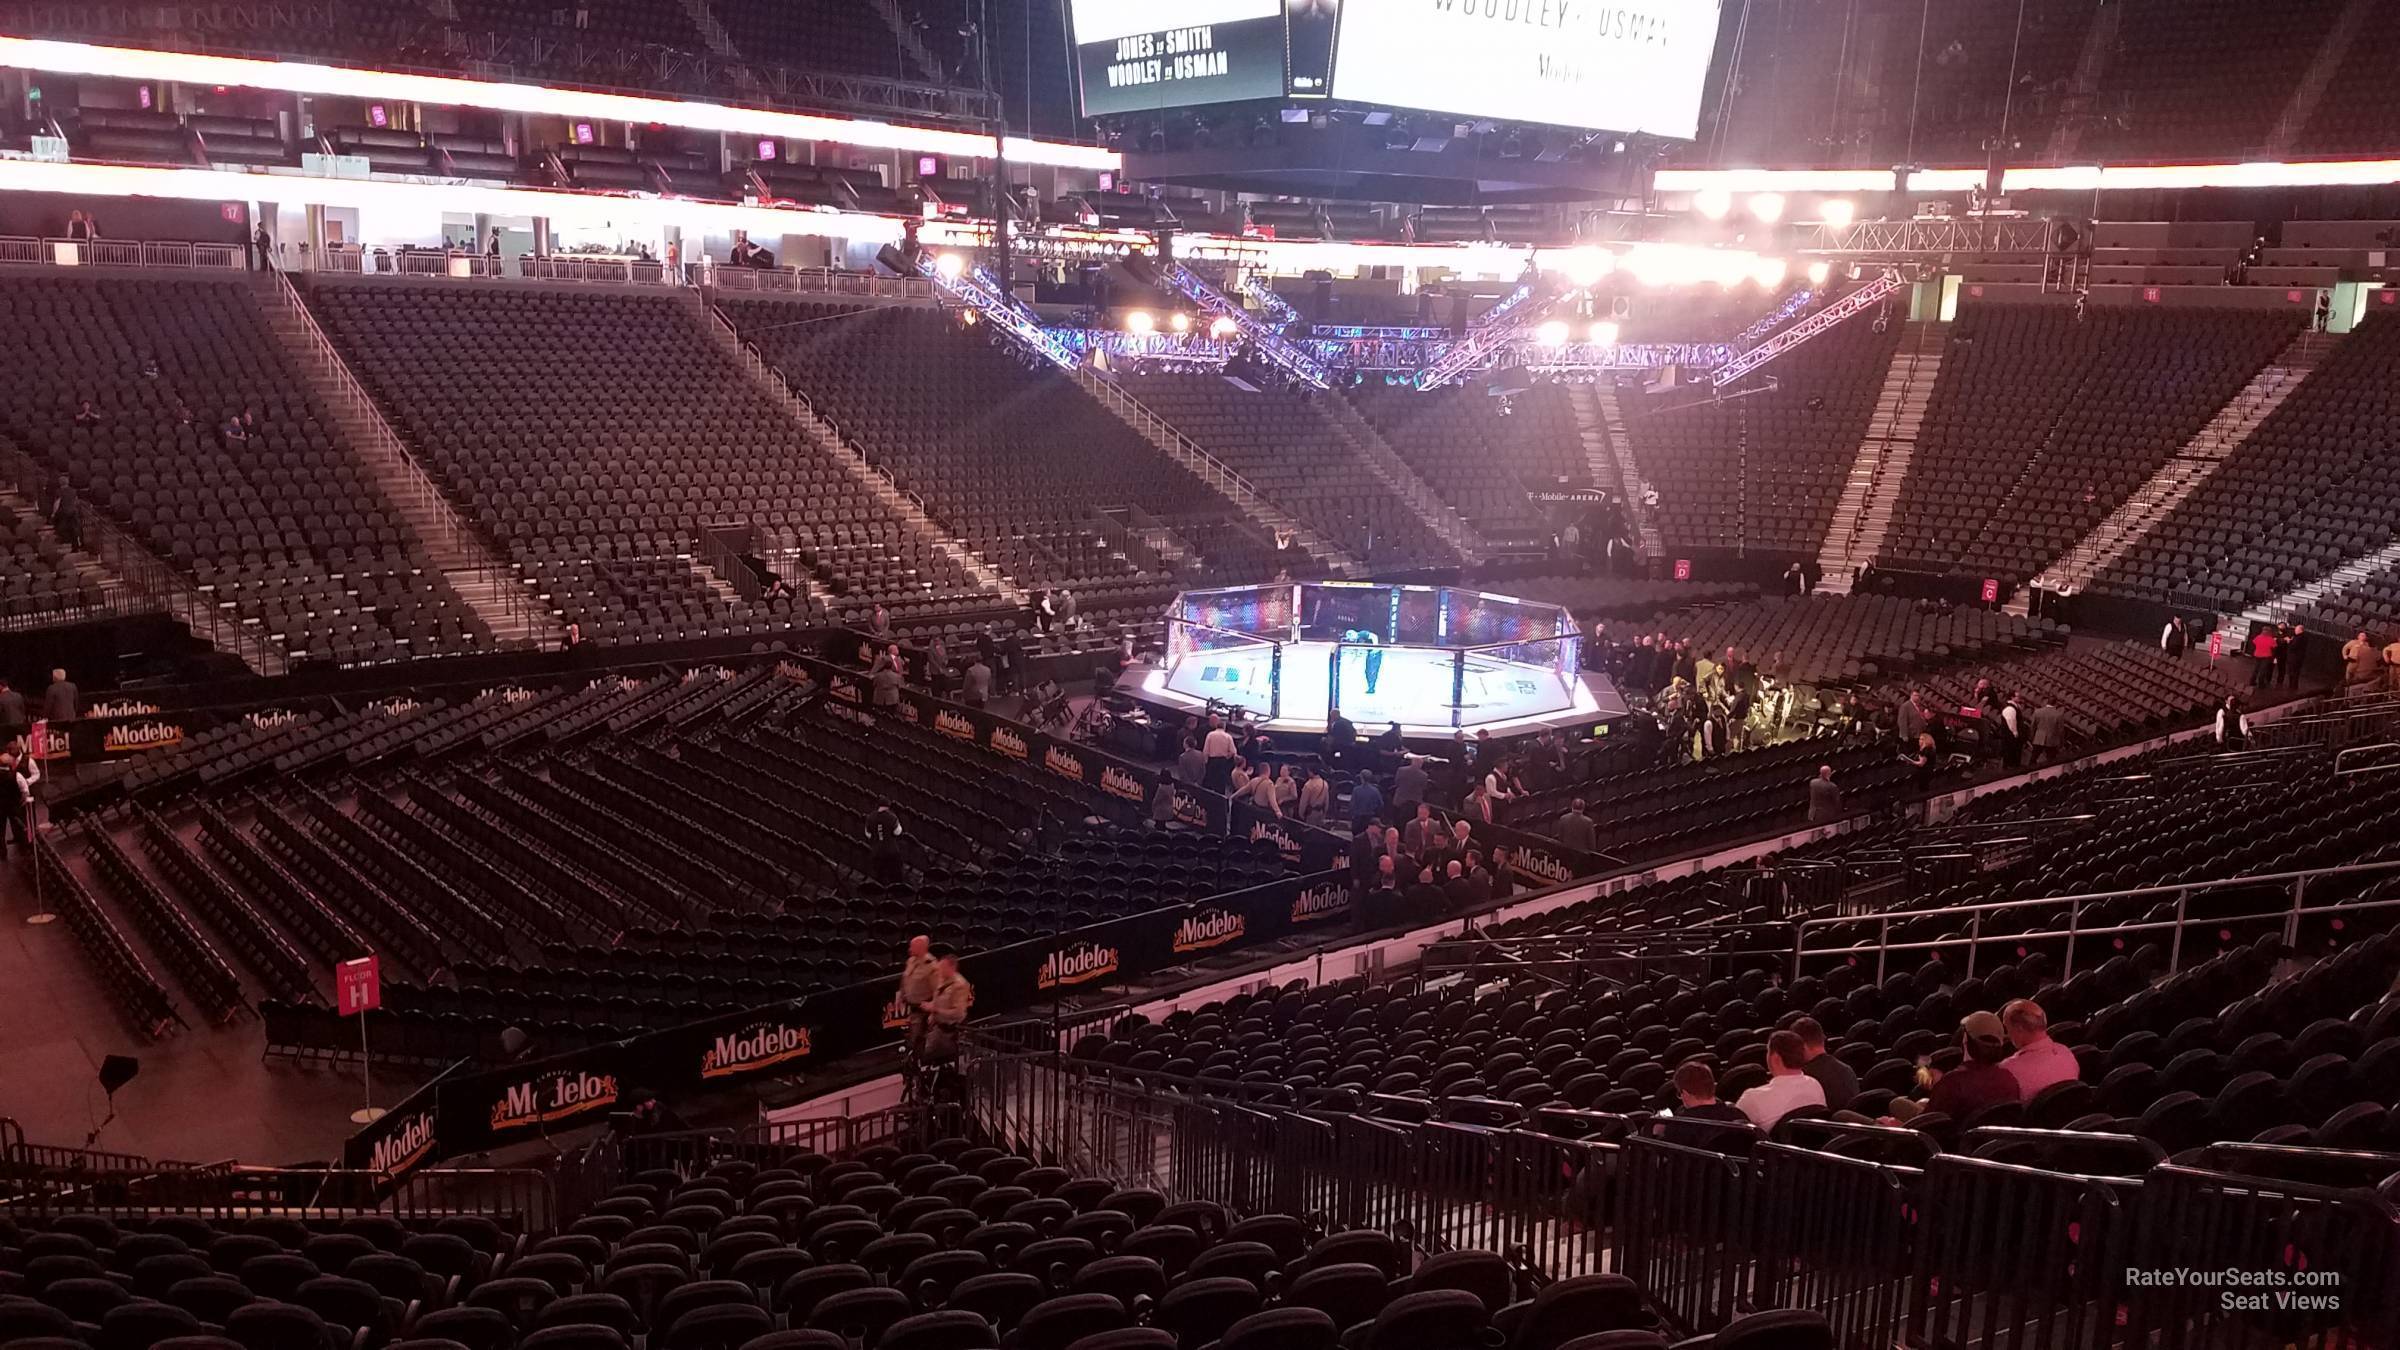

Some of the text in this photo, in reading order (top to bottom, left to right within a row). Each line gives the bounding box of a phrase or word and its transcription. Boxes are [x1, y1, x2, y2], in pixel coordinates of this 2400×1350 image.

[1115, 34, 1154, 61] JONES
[1166, 26, 1212, 54] SMITH
[1107, 59, 1162, 88] WOODLEY
[1174, 51, 1228, 80] USMAN
[1679, 569, 1686, 577] D
[112, 720, 174, 745] Modelo
[1106, 765, 1139, 794] Modelo
[1518, 846, 1567, 882] Modelo
[1300, 883, 1349, 914] Modelo
[1183, 910, 1238, 943] Modelo
[1049, 944, 1109, 978] Modelo
[350, 983, 369, 1008] H
[715, 1023, 798, 1067] Modelo
[374, 1111, 435, 1171] Modelo
